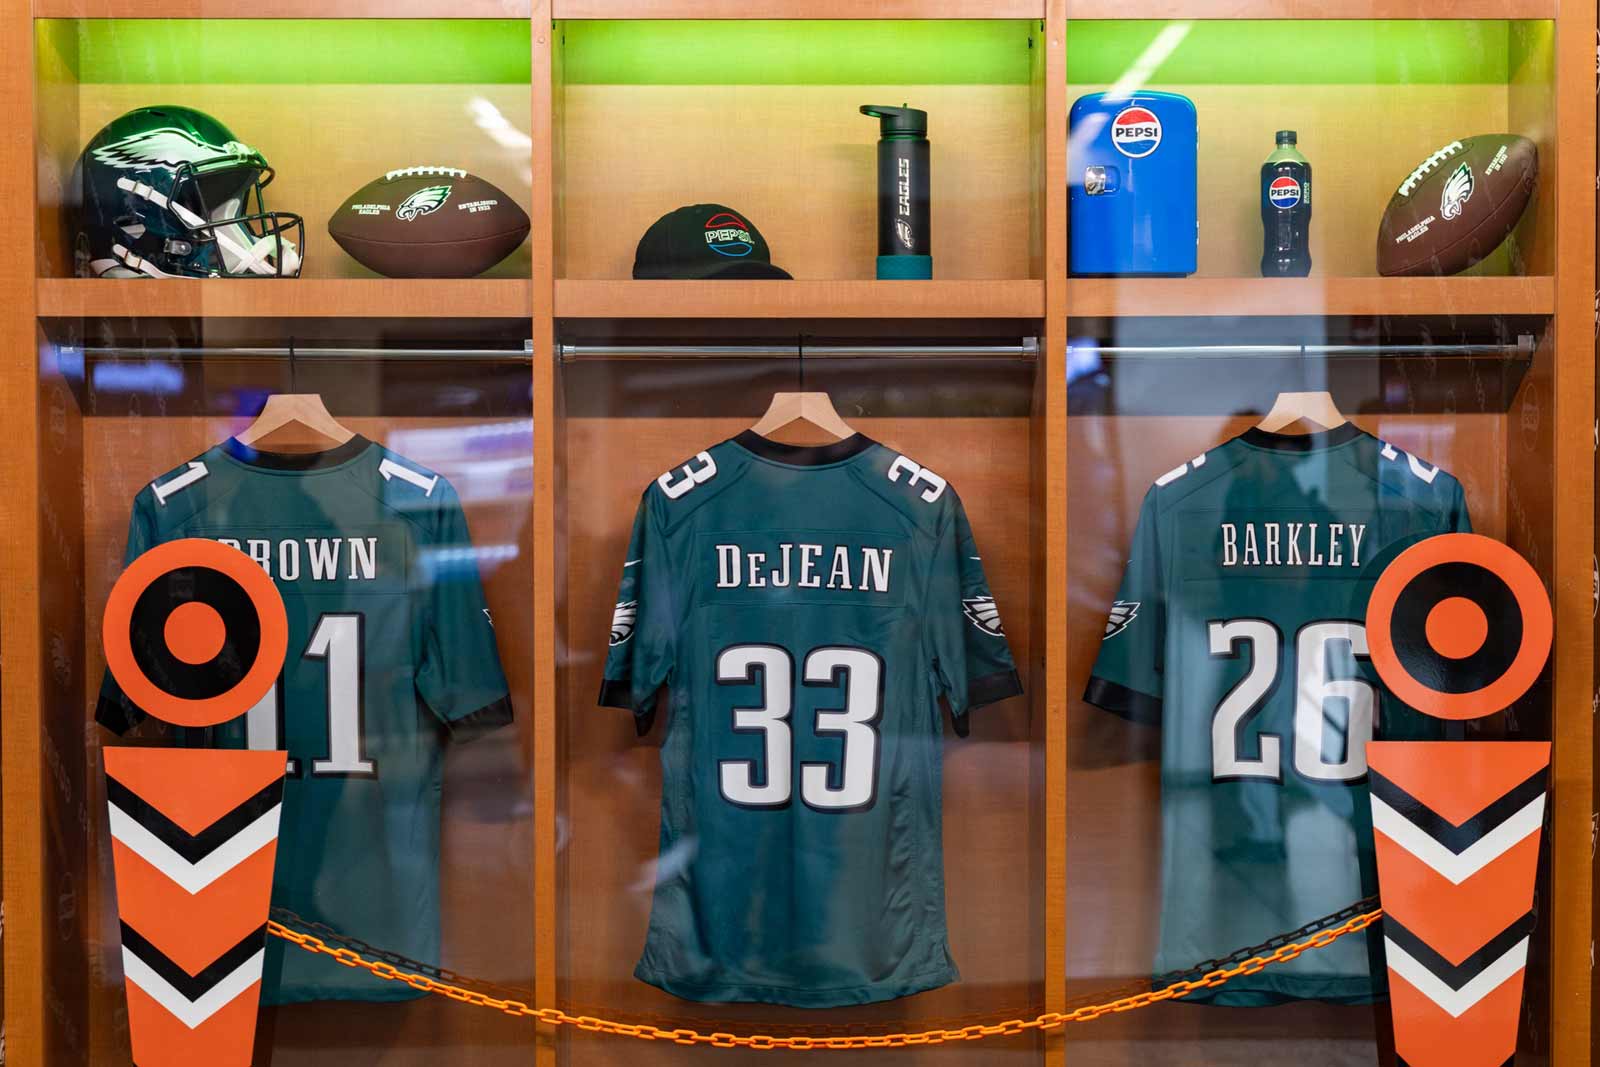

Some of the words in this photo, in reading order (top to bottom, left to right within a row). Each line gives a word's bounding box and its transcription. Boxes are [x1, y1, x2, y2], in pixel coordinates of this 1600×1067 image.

[1115, 127, 1158, 138] PEPSI
[899, 158, 910, 216] EAGLES
[1271, 189, 1299, 197] PEPSI
[1395, 215, 1436, 244] PHILADELPHIA
[1406, 225, 1429, 243] EAGLES
[150, 461, 209, 506] 1
[378, 458, 439, 498] 1
[657, 450, 718, 500] 3
[887, 455, 947, 503] 3
[1221, 523, 1367, 567] BARKLEY
[715, 543, 894, 593] DeJEAN
[1208, 619, 1374, 782] 26
[716, 644, 885, 812] 33
